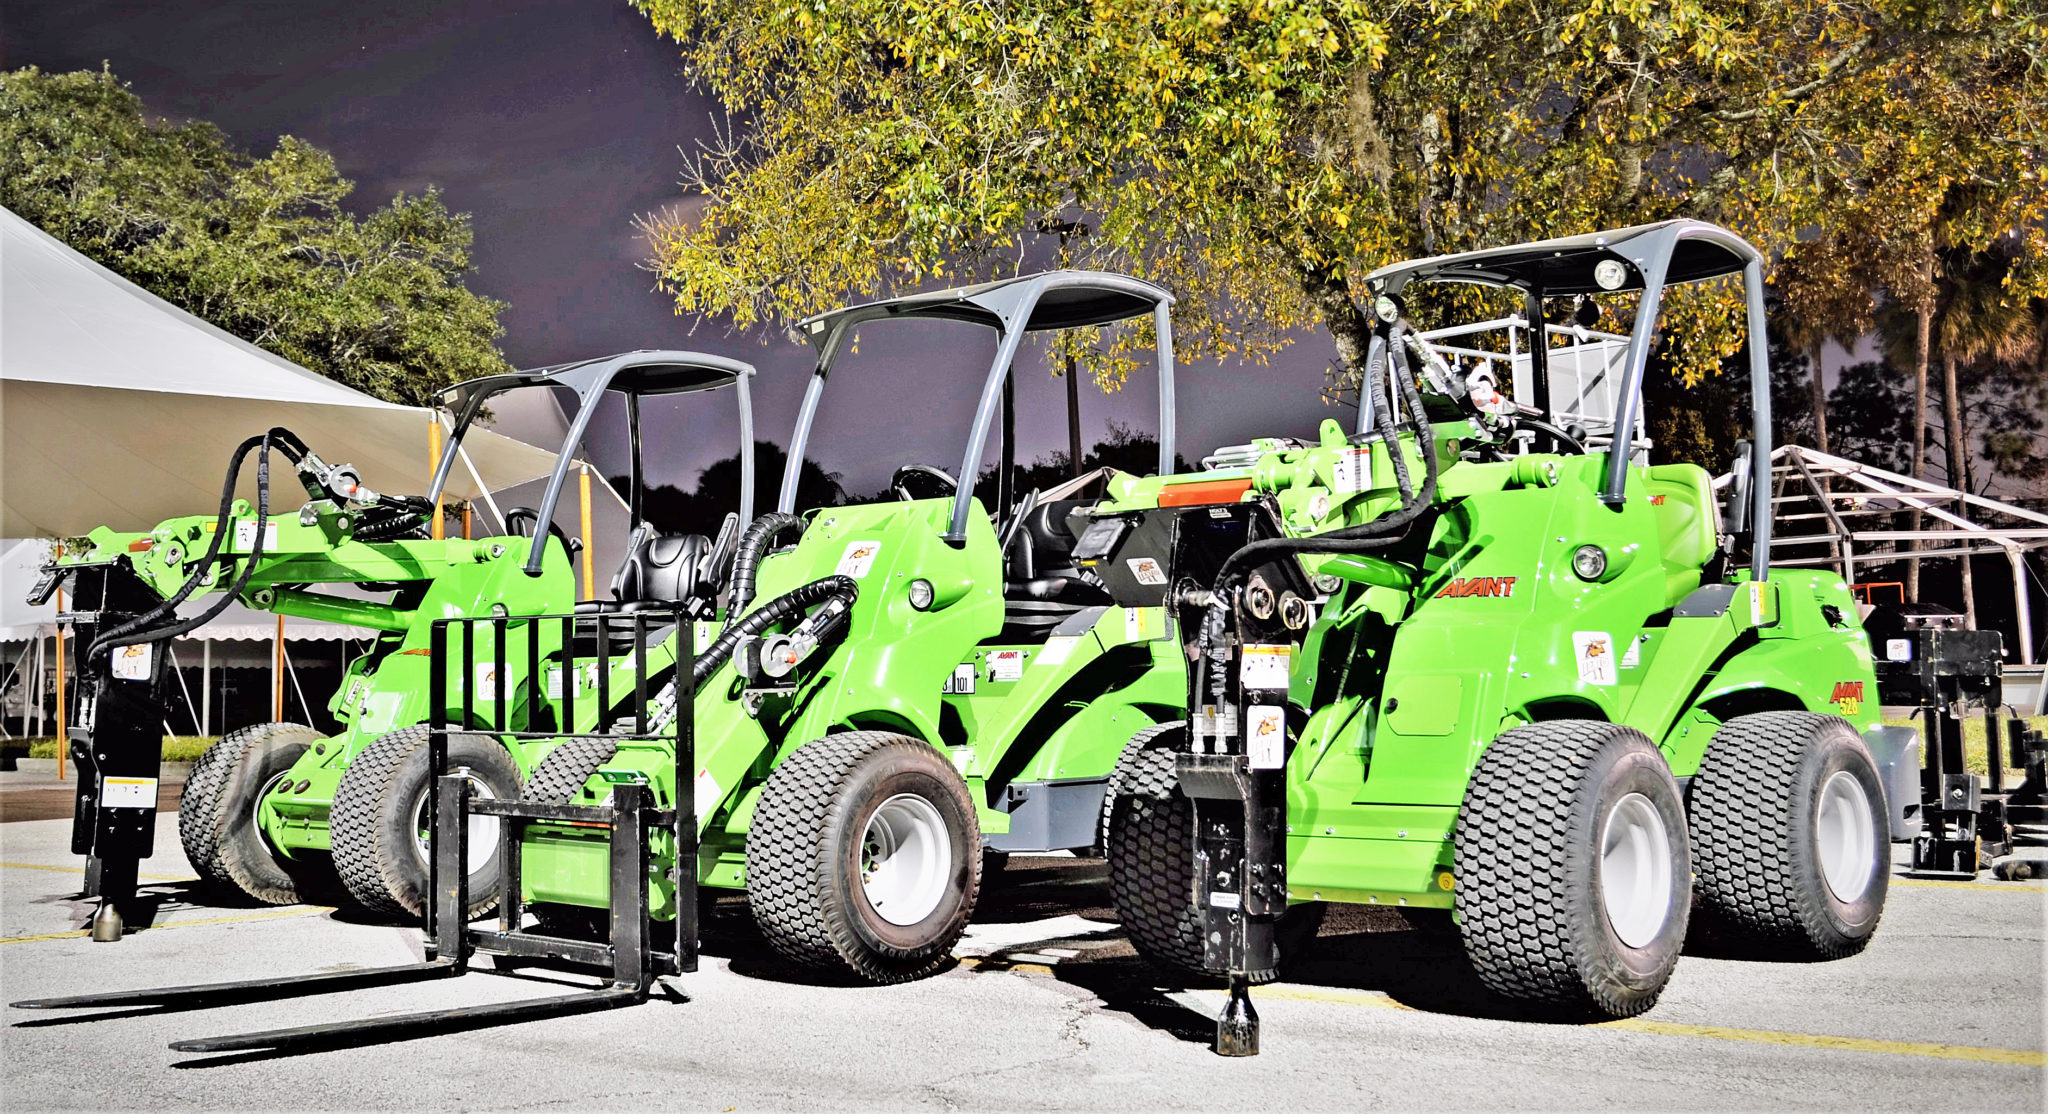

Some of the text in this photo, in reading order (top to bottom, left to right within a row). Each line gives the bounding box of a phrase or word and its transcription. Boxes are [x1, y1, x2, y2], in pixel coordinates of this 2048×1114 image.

[1434, 577, 1516, 598] AVANT
[997, 651, 1018, 660] AVANT
[957, 677, 968, 692] 101
[1829, 681, 1863, 704] AVANT
[1840, 696, 1858, 716] 528
